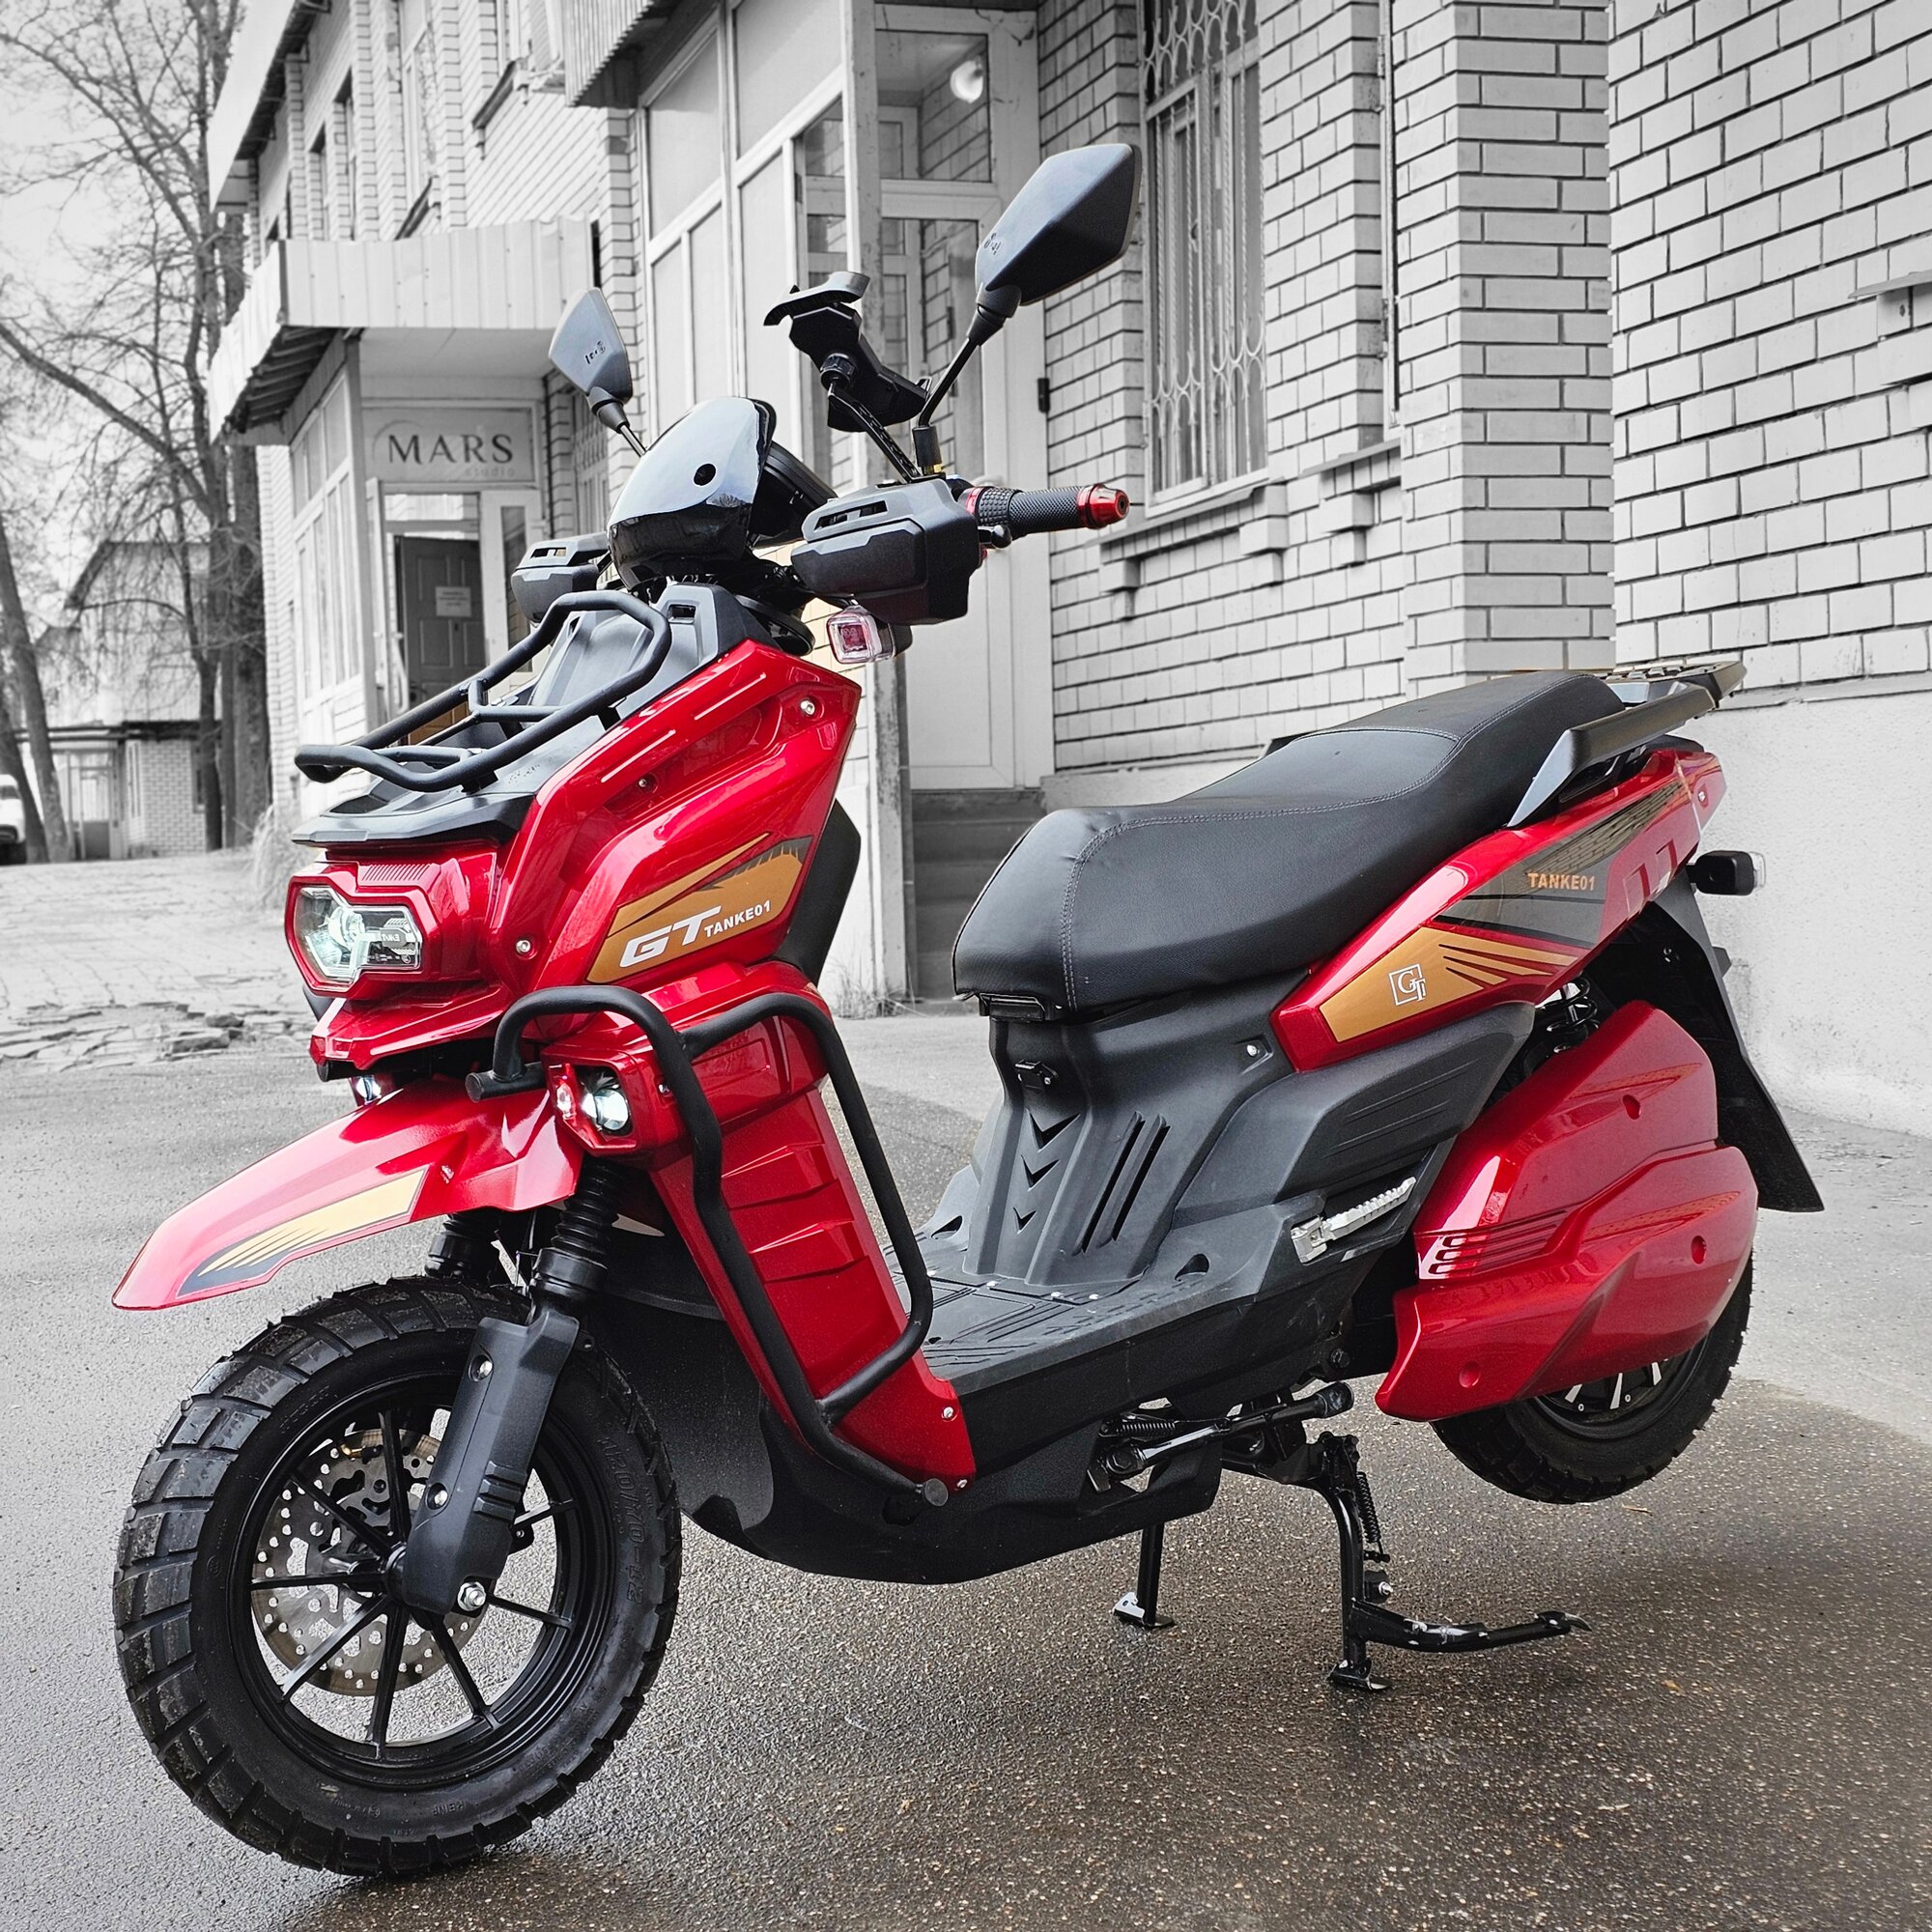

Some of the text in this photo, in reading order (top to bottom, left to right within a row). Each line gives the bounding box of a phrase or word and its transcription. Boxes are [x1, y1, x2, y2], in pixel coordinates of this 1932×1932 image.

[388, 434, 514, 465] MARS
[465, 468, 516, 477] studio
[1527, 872, 1596, 892] TANKE01
[619, 899, 772, 968] GT TANKE01
